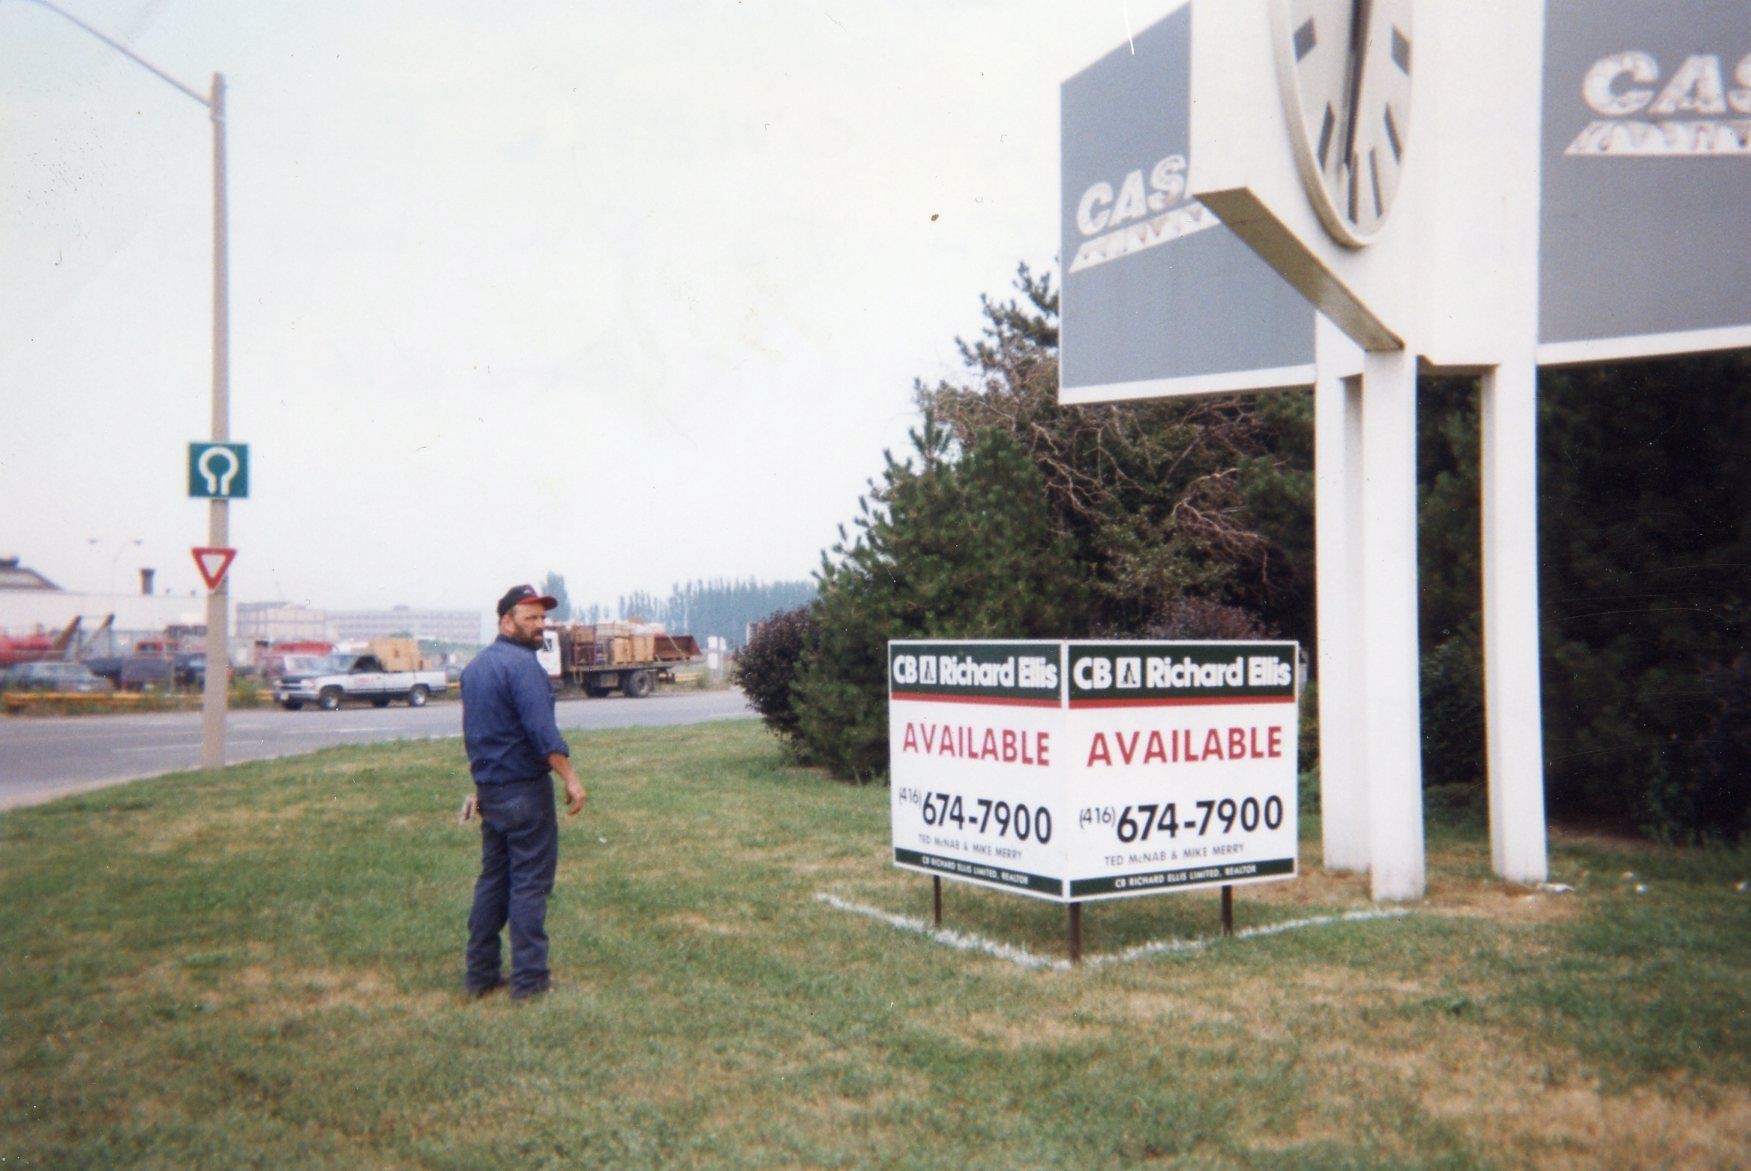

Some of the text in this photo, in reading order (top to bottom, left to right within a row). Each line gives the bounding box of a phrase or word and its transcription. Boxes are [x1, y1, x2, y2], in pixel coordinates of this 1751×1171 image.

[893, 655, 1059, 689] CB Richard Ellis
[1073, 656, 1291, 690] CB Richard Ellis
[903, 722, 1050, 767] AVAILABLE
[1087, 726, 1282, 767] AVAILABLE
[922, 791, 1053, 845] 674-7900
[1116, 795, 1284, 844] 674-7900
[918, 833, 931, 845] TED
[973, 843, 992, 857] MIKE
[995, 847, 1023, 861] MERRY
[931, 857, 957, 870] RICHARD
[1105, 856, 1124, 867] TED
[1171, 851, 1178, 860] &
[1183, 847, 1208, 859] MIKE
[1212, 844, 1244, 856] MERRY
[1114, 879, 1126, 888] CB
[1129, 874, 1164, 887] RICHARD
[1167, 872, 1187, 883] ELLIS
[1224, 864, 1257, 876] REALTOR
